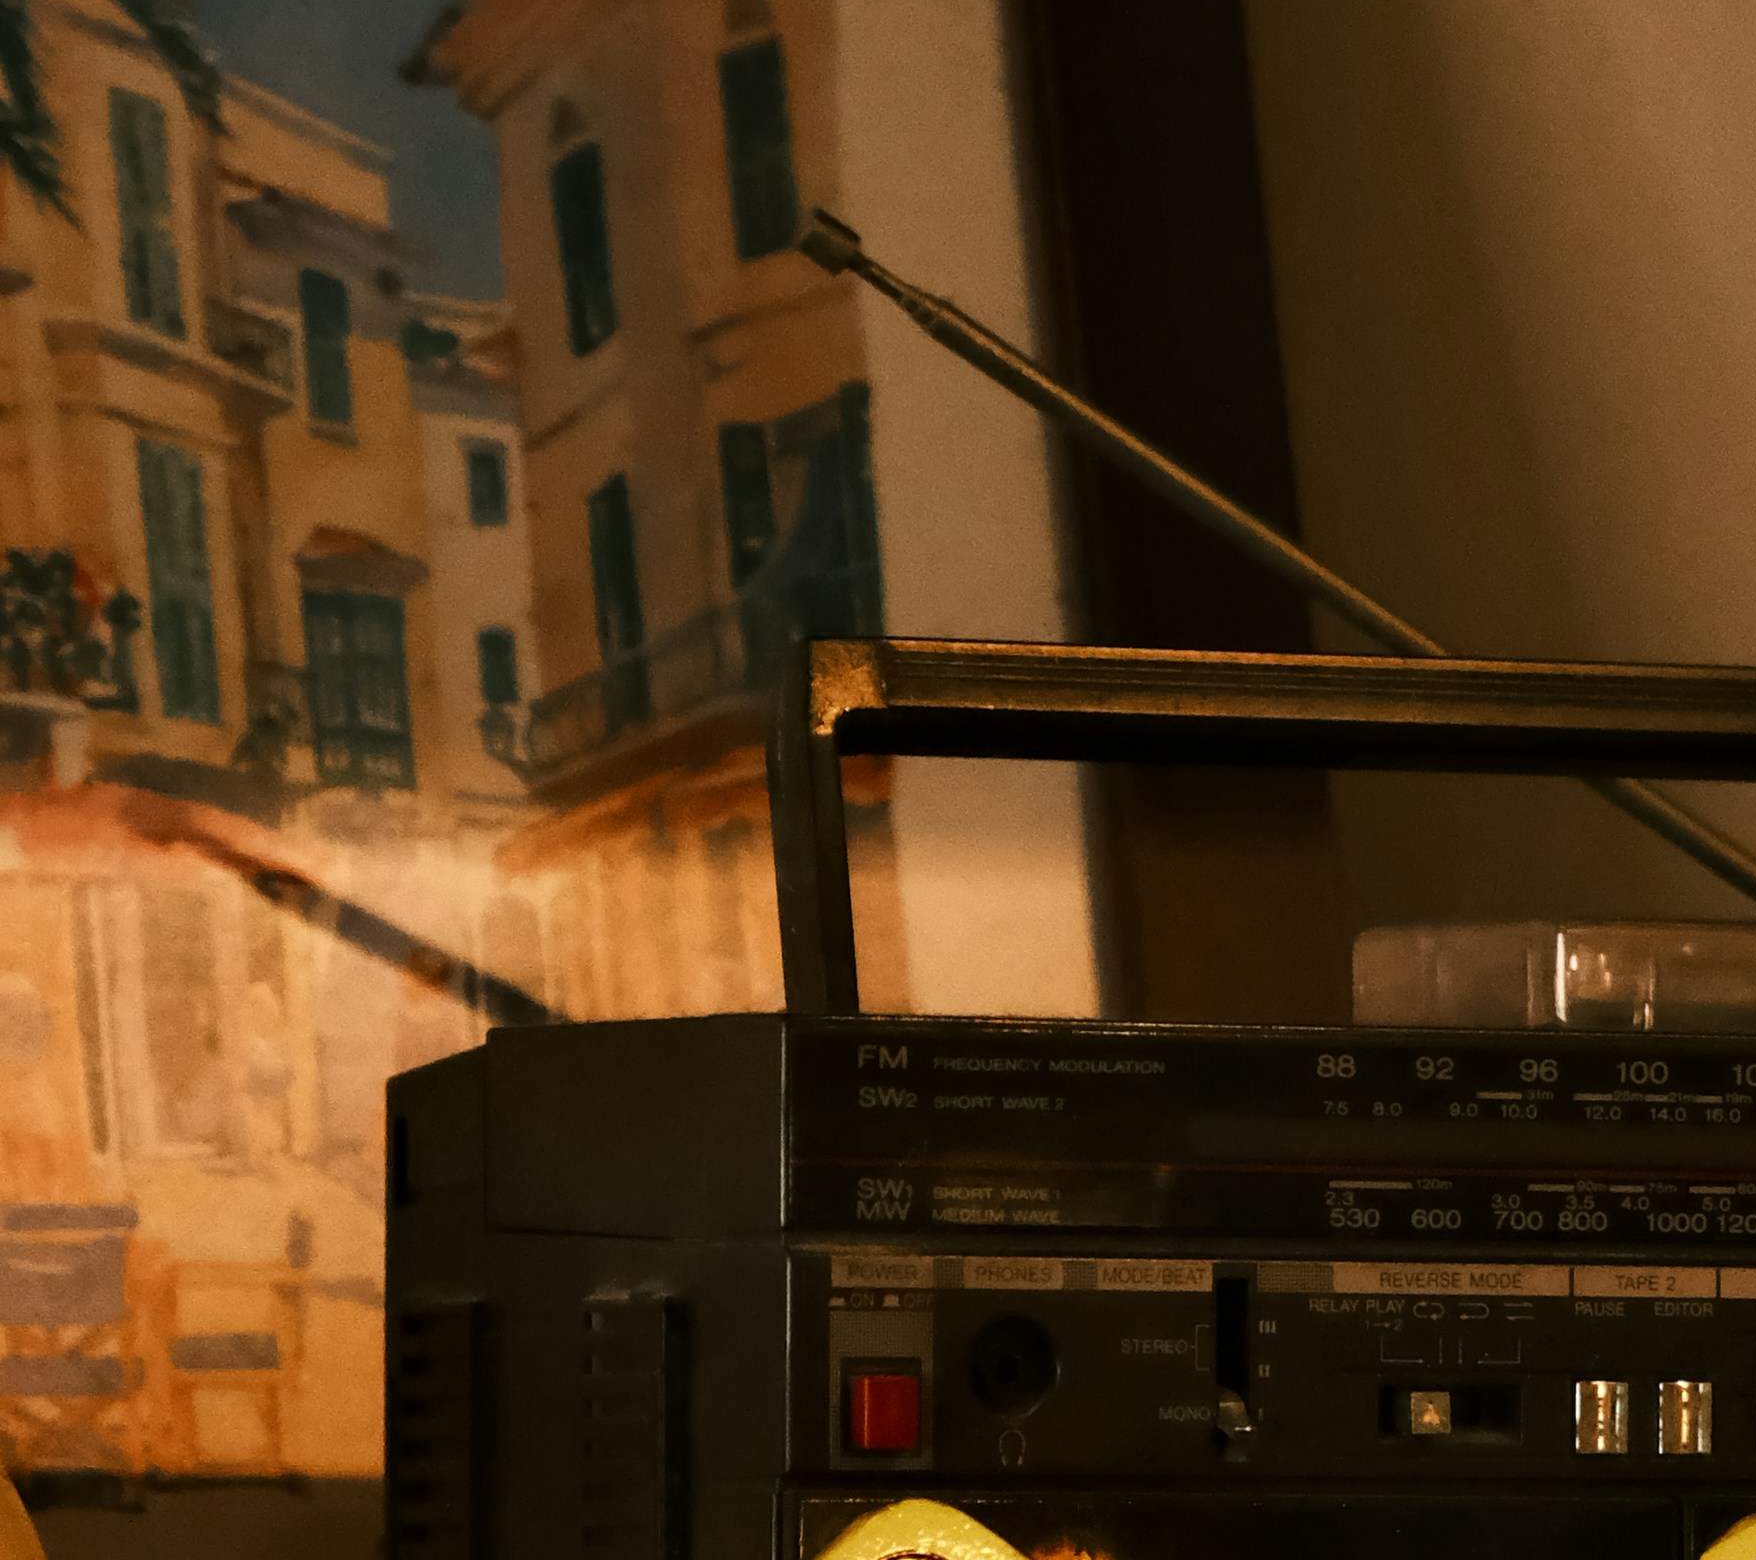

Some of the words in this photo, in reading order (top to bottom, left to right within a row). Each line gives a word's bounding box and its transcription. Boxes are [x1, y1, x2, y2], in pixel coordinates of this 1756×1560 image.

[857, 1045, 909, 1071] FM
[932, 1056, 1041, 1073] FREQUENCY
[1048, 1059, 1166, 1075] MODULATION
[1316, 1053, 1357, 1079] 88
[1415, 1056, 1455, 1081] 92
[1519, 1058, 1559, 1083] 96
[1616, 1060, 1670, 1085] 100
[857, 1085, 919, 1109] SW2
[932, 1095, 995, 1110] SHORT
[1002, 1096, 1051, 1111] WAVE
[1054, 1096, 1066, 1111] 2
[1322, 1100, 1349, 1116] 7.5
[1372, 1101, 1403, 1117] 8.0
[1449, 1101, 1479, 1118] 9.0
[1500, 1104, 1538, 1120] 10.0
[1584, 1105, 1622, 1121] 12.0
[1650, 1106, 1687, 1123] 14.0
[1704, 1107, 1741, 1124] 16.0
[856, 1177, 913, 1200] SW1
[931, 1186, 993, 1201] SHORT
[1001, 1187, 1052, 1201] WAVE
[1416, 1178, 1453, 1191] 120m
[1324, 1190, 1354, 1207] 2.3
[1490, 1193, 1521, 1209] 3.0
[1565, 1194, 1595, 1210] 3.5
[1620, 1195, 1650, 1211] 4.0
[1702, 1197, 1732, 1213] 5.0
[855, 1200, 911, 1223] MW
[931, 1208, 1001, 1224] MEDIUM
[1013, 1208, 1063, 1224] WAVE
[1328, 1208, 1381, 1229] 530
[1410, 1208, 1462, 1230] 600
[1493, 1209, 1544, 1232] 700
[1557, 1210, 1608, 1232] 800
[1646, 1212, 1708, 1234] 1000
[847, 1264, 919, 1280] POWER
[975, 1266, 1051, 1282] PHONES
[1102, 1267, 1206, 1285] MODE/BEAT
[1379, 1271, 1461, 1289] REVERSE
[1470, 1272, 1523, 1289] MODE
[1616, 1274, 1659, 1290] TAPE
[1666, 1276, 1677, 1291] 2
[850, 1294, 875, 1308] ON
[902, 1294, 934, 1308] OFF
[1308, 1298, 1358, 1313] RELAY
[1366, 1299, 1406, 1314] PLAY
[1574, 1301, 1625, 1317] PAUSE
[1654, 1302, 1714, 1318] EDITOR
[1120, 1339, 1188, 1355] STEREO
[1158, 1406, 1211, 1421] MONO
